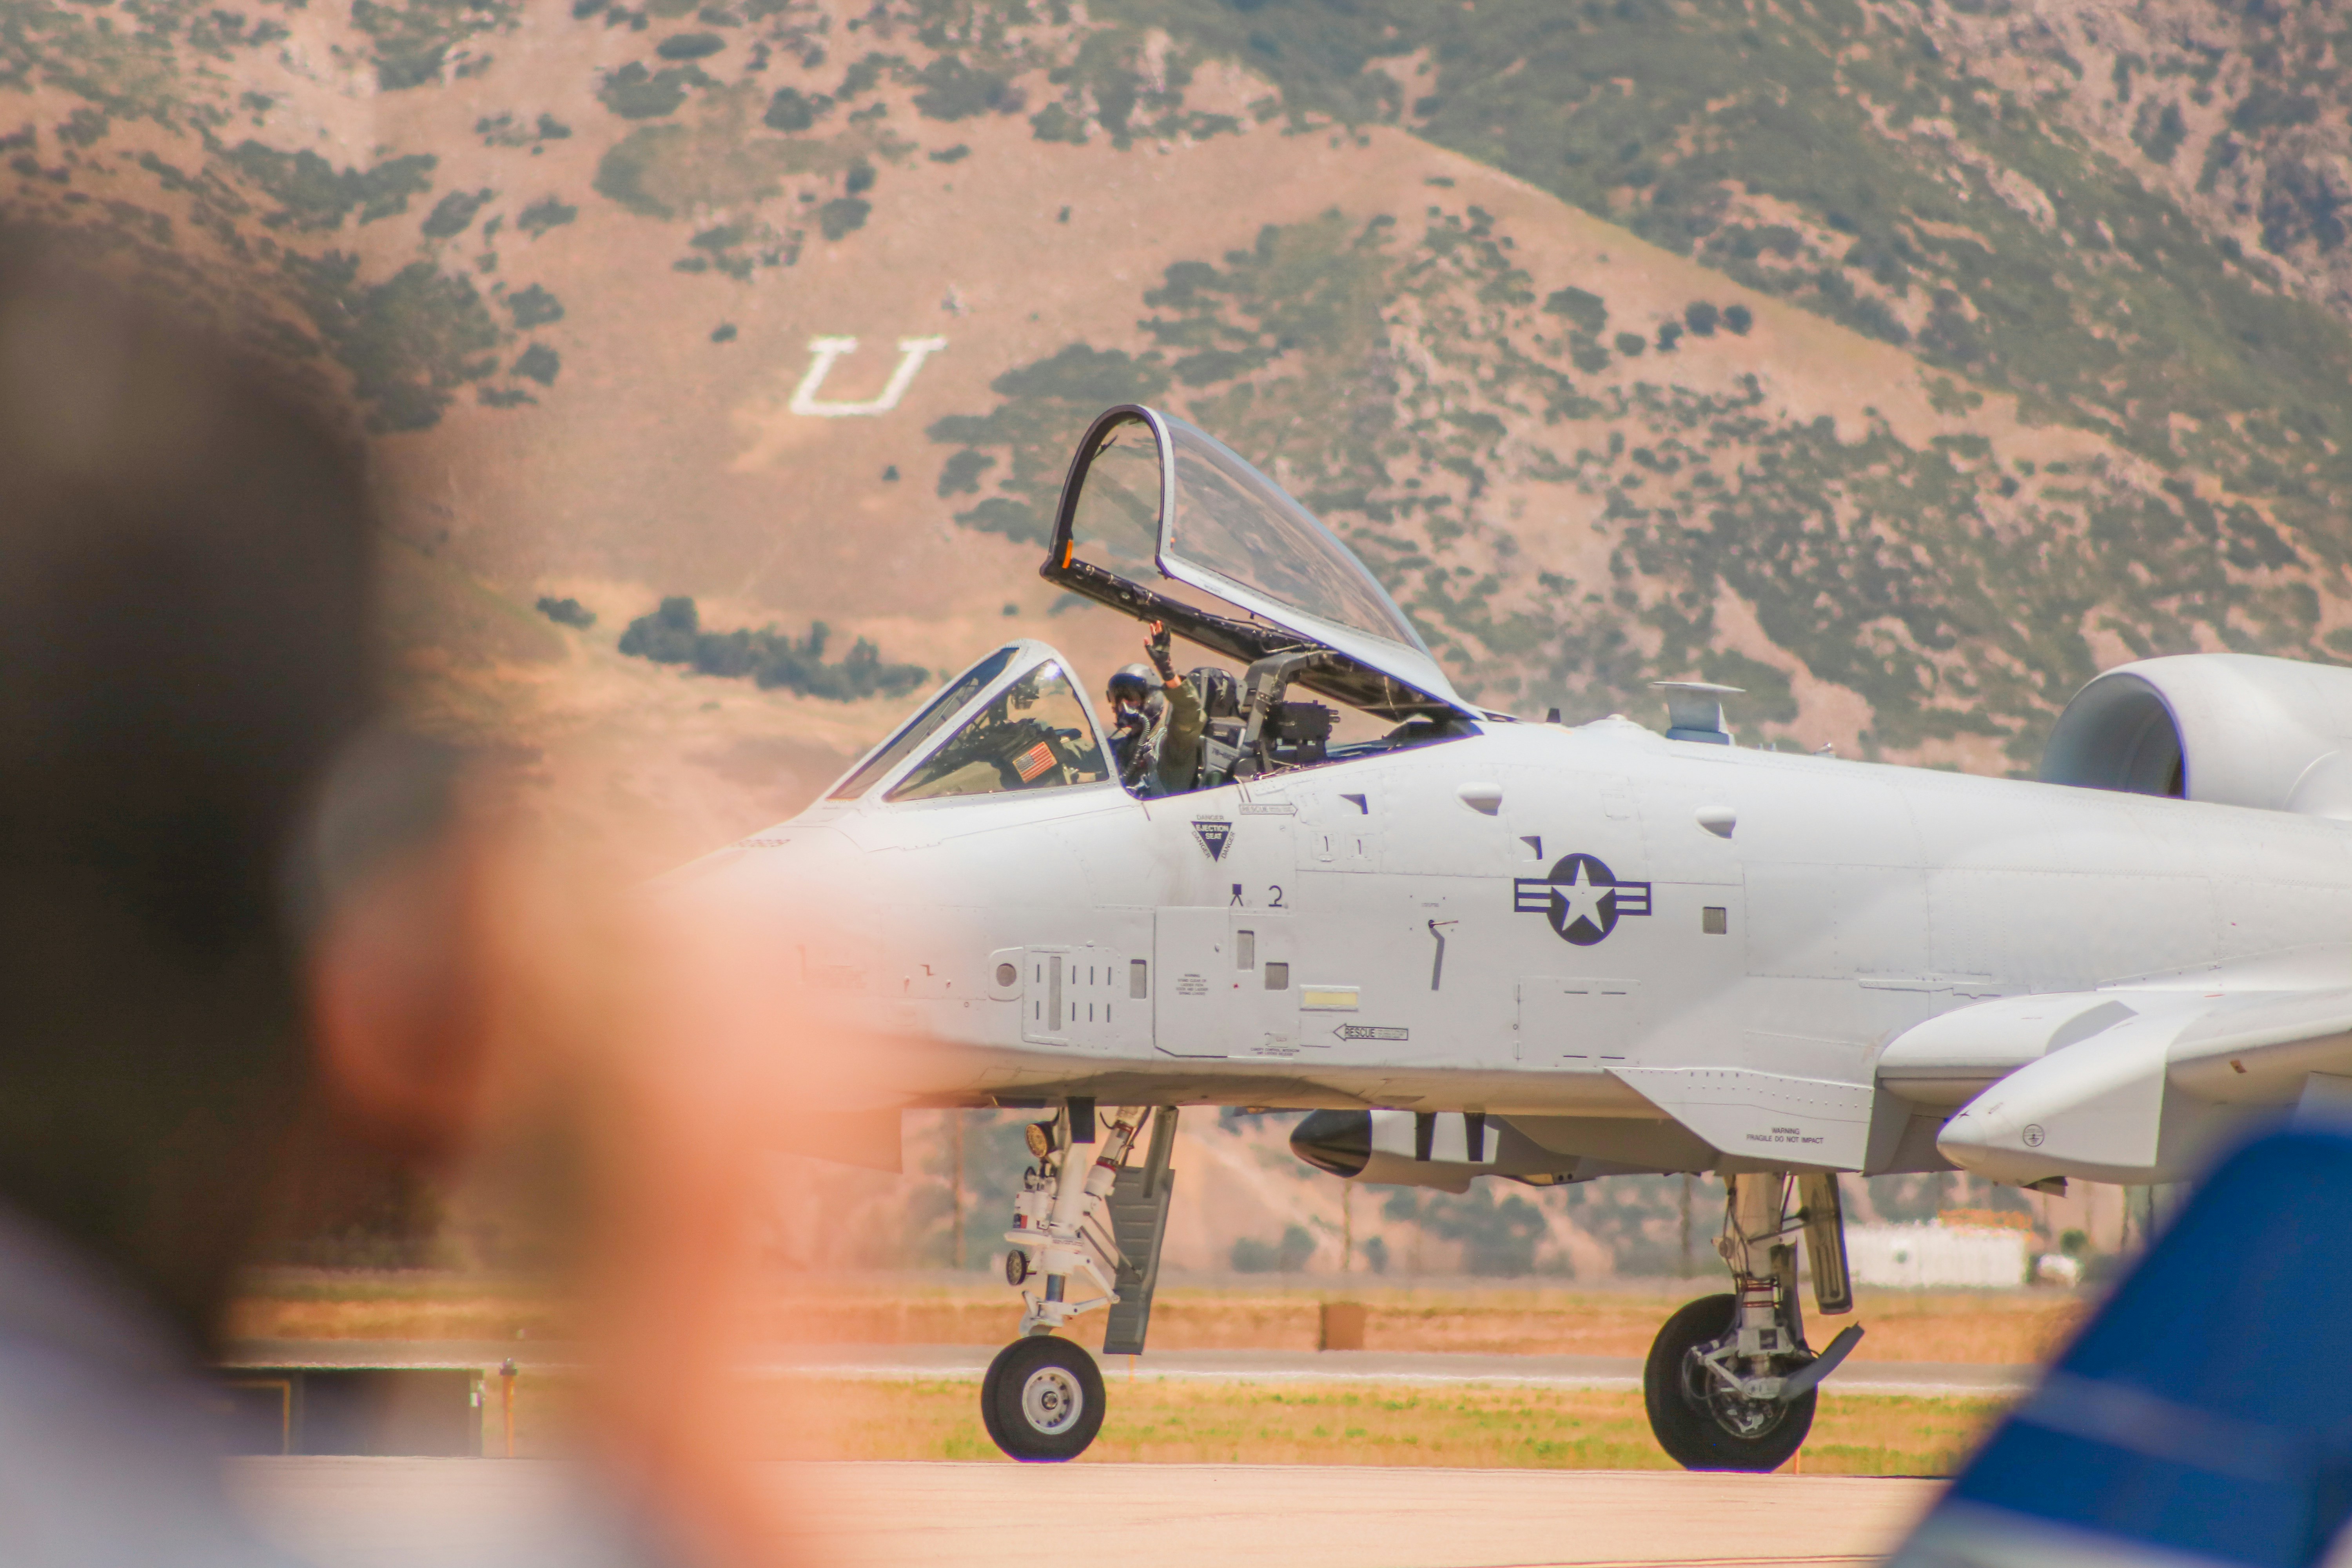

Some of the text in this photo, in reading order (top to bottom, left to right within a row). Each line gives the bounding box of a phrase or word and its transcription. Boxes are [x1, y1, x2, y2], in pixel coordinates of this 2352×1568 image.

[789, 336, 948, 417] U
[1191, 830, 1211, 858] DANGER
[1221, 831, 1235, 858] DANGER
[1345, 1028, 1375, 1038] RESCUE
[1746, 1134, 1772, 1142] FRAGILE
